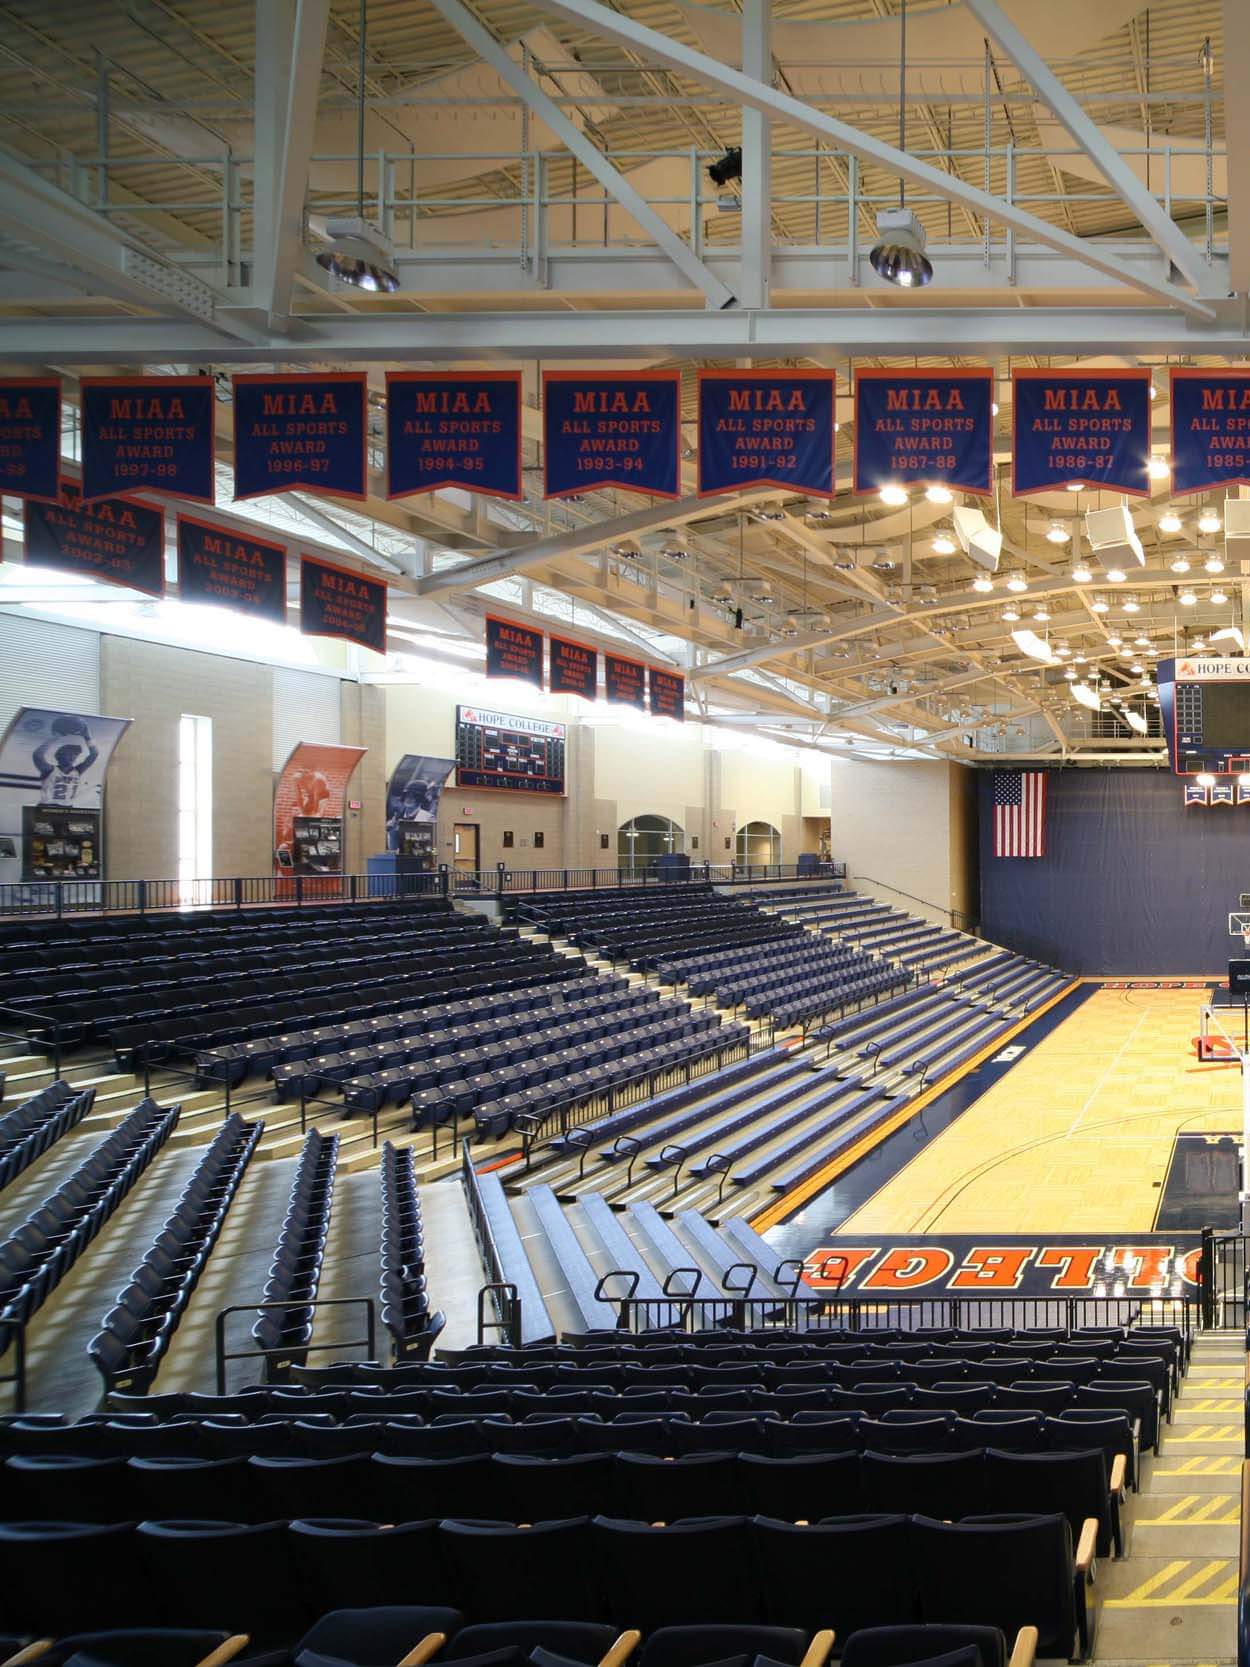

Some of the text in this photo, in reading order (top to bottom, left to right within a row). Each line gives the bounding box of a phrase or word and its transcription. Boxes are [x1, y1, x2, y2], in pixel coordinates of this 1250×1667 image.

[263, 394, 336, 415] MIAA
[416, 392, 491, 413] MIAA
[573, 392, 651, 413] MIAA
[728, 390, 806, 411] MIAA
[887, 389, 964, 411] MIAA
[1044, 389, 1122, 411] MIAA
[111, 399, 184, 419] MIAA
[251, 422, 348, 436] ALL SPORTS
[403, 421, 502, 434] ALL SPORTS
[562, 419, 660, 433] ALL SPORTS
[717, 418, 815, 432] ALL SPORTS
[875, 418, 974, 432] ALL SPORTS
[1032, 418, 1132, 432] ALL SPORTS
[1191, 417, 1220, 431] ALL
[99, 427, 194, 440] ALL SPORTS
[270, 441, 326, 454] AWARD
[422, 440, 479, 452] AWARD
[581, 439, 639, 452] AWARD
[736, 437, 794, 450] AWARD
[895, 436, 952, 449] AWARD
[1051, 437, 1111, 450] AWARD
[116, 446, 174, 458] AWARD
[419, 458, 484, 471] 1994-95
[576, 457, 643, 471] 1993-94
[731, 456, 796, 469] 1991-92
[890, 455, 957, 469] 1987-88
[1048, 455, 1114, 469] 1986-87
[203, 535, 264, 567] MIAA
[320, 573, 369, 599] MIAA
[1197, 663, 1232, 674] HOPE
[480, 712, 505, 727] HOPE
[509, 717, 550, 733] COLLEGE
